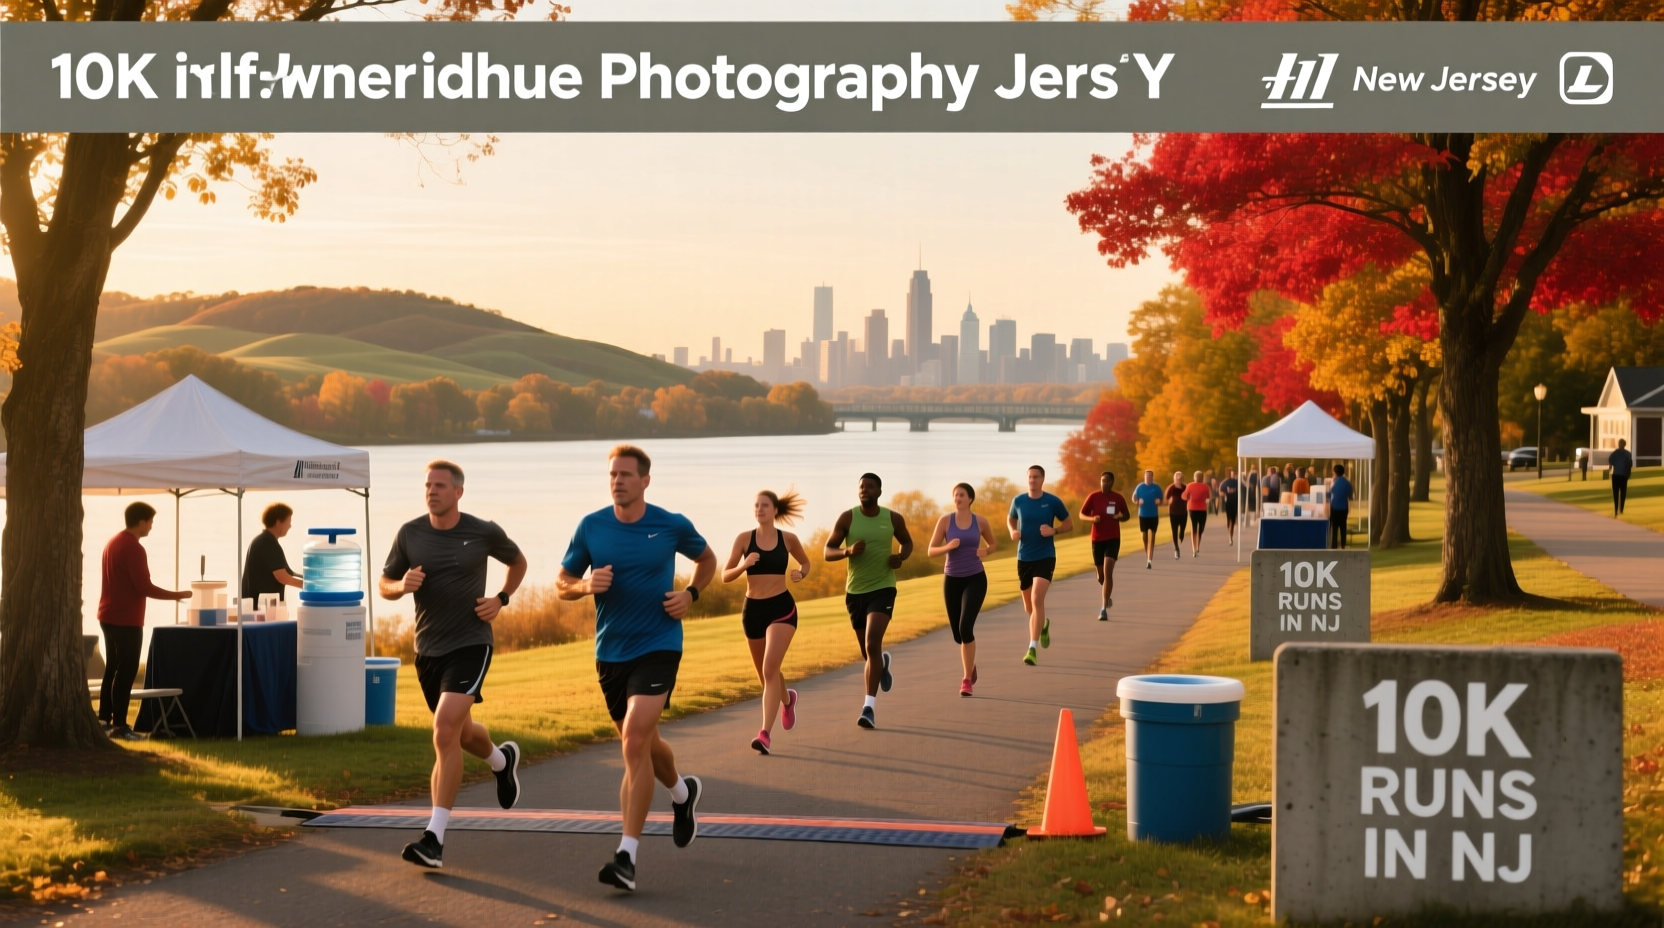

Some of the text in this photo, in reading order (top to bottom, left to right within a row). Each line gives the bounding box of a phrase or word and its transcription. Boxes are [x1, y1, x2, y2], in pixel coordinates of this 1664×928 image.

[1279, 560, 1339, 588] 10K
[1278, 592, 1342, 611] RUNS
[1280, 614, 1340, 632] IN NJ
[1362, 679, 1532, 759] 10K
[1360, 766, 1538, 821] RUNS
[1364, 827, 1533, 884] IN NJ
